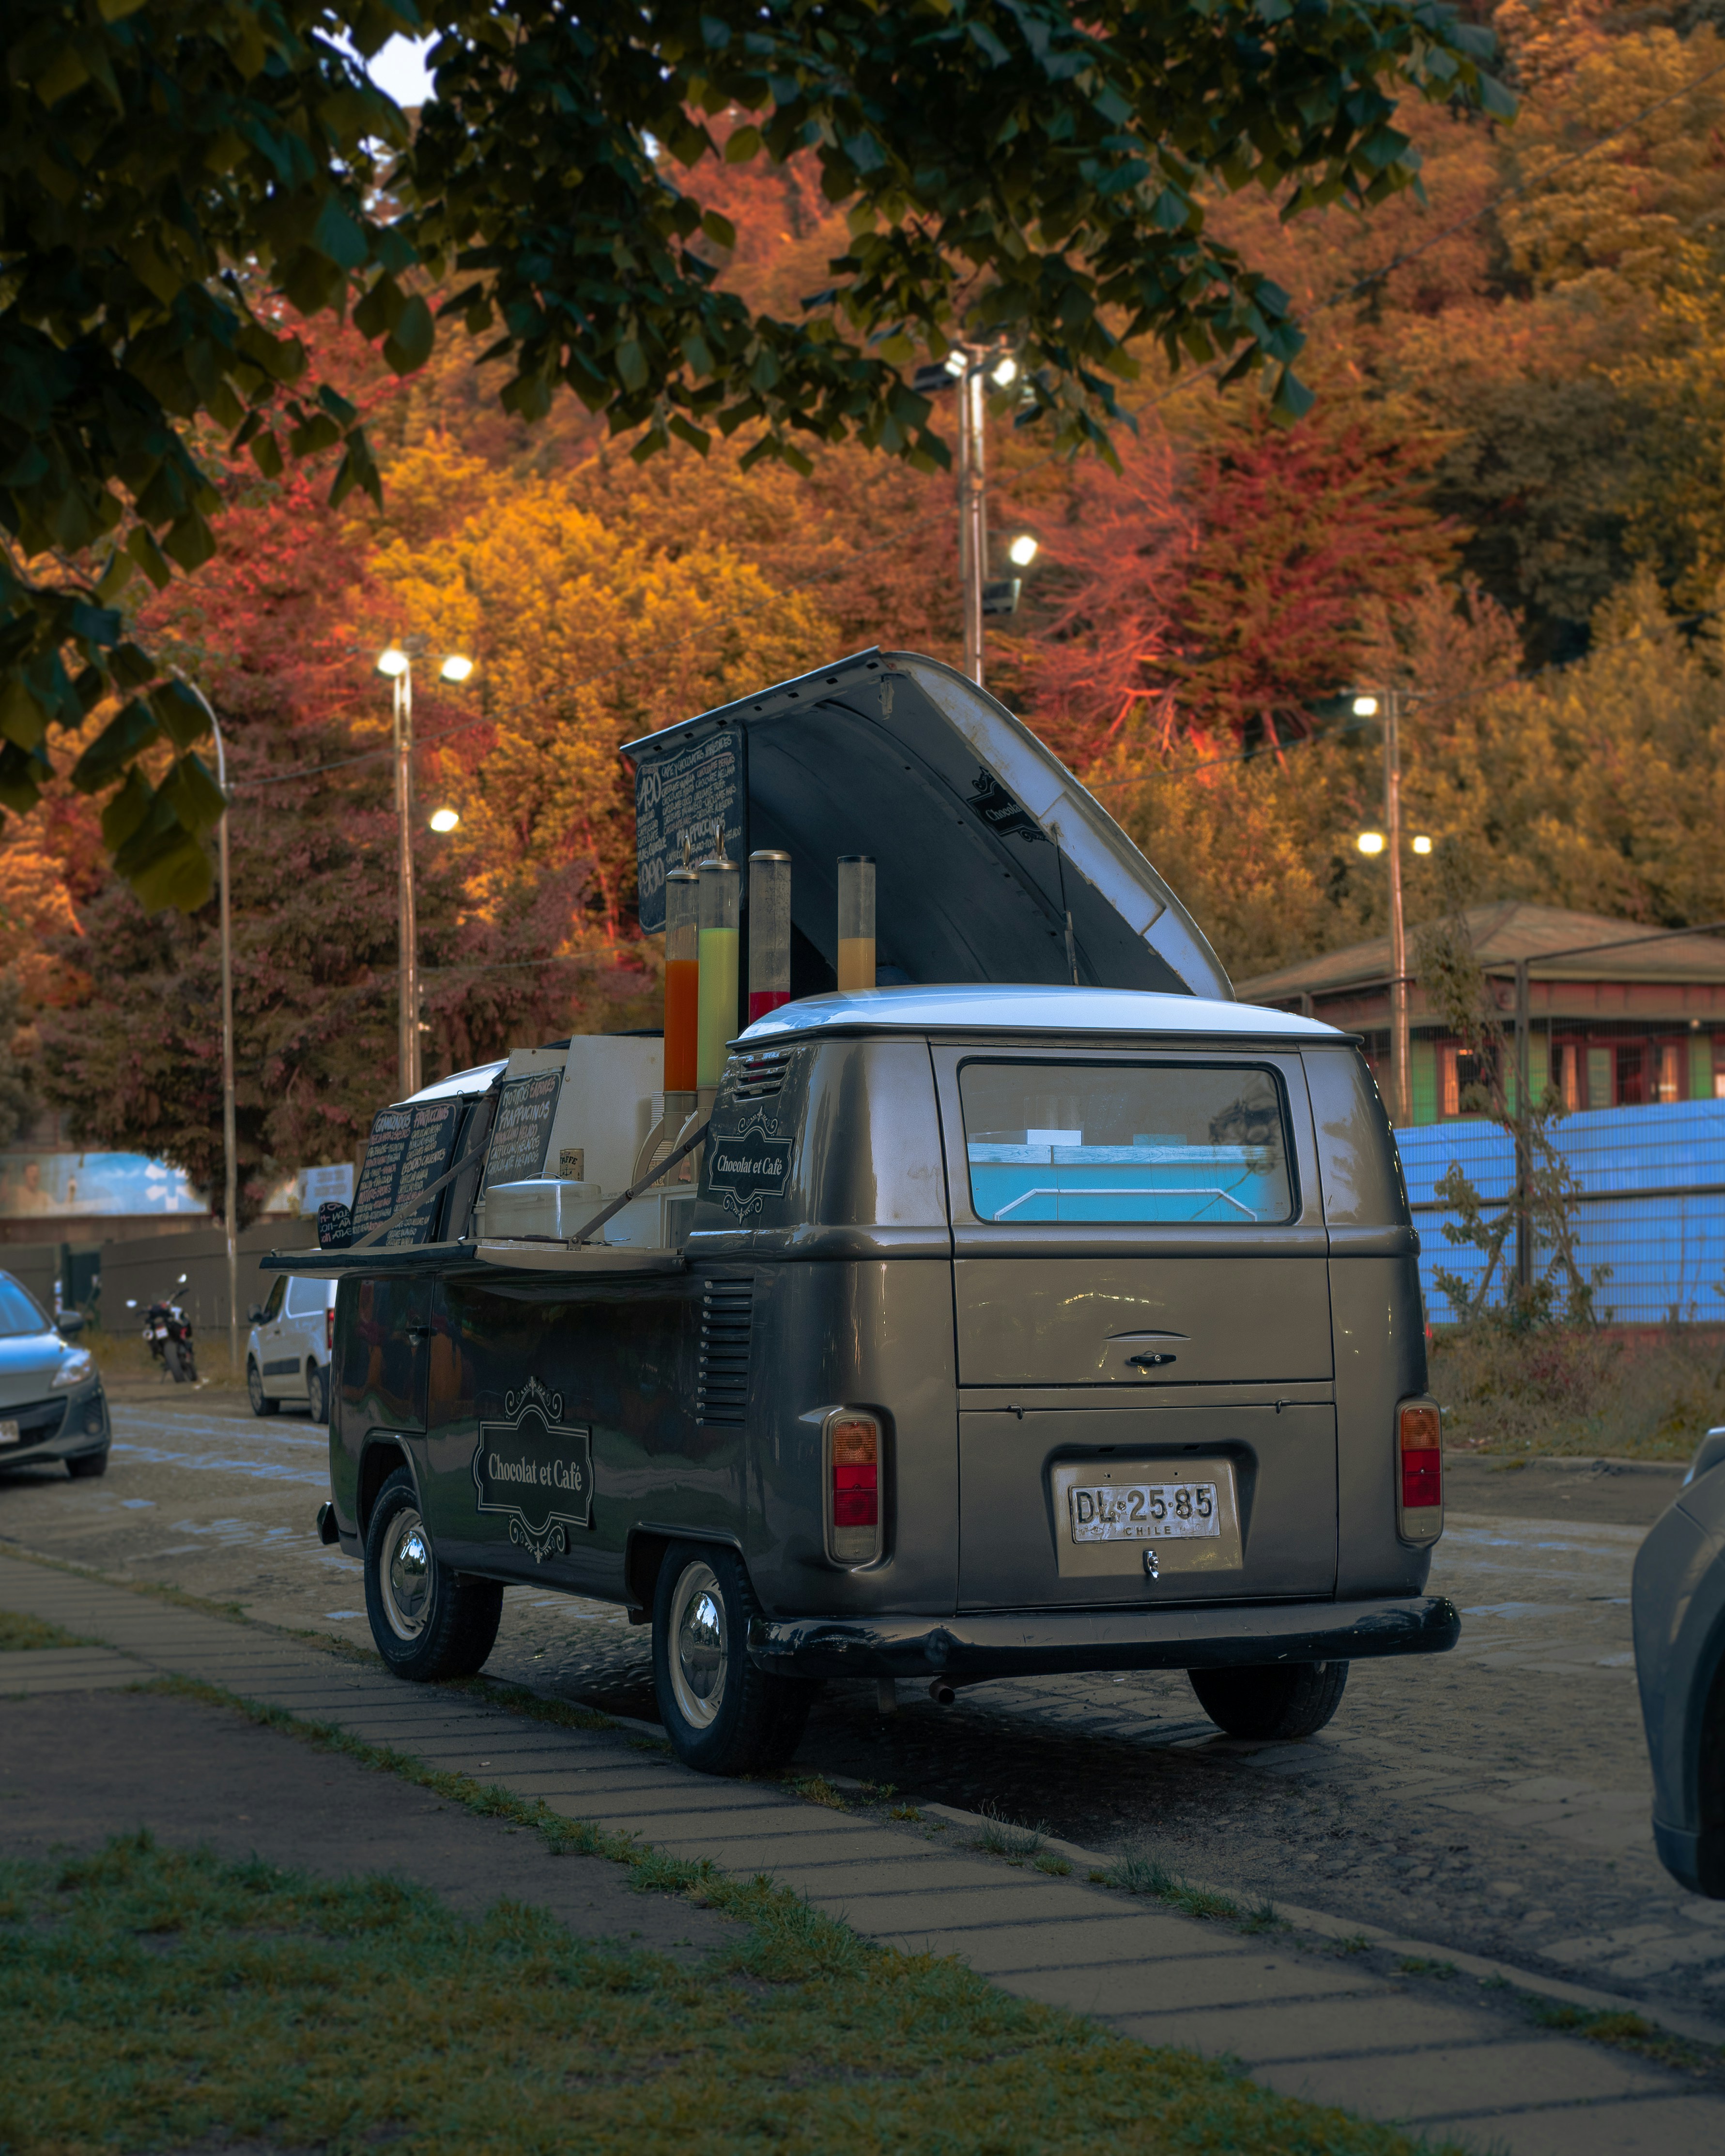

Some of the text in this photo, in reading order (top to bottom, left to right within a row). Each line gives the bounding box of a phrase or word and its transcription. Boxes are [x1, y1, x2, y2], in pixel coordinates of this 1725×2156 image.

[717, 1155, 783, 1175] Chocolat et Café
[489, 1453, 582, 1491] Chocolat et Café
[1125, 1525, 1172, 1536] CHILE
